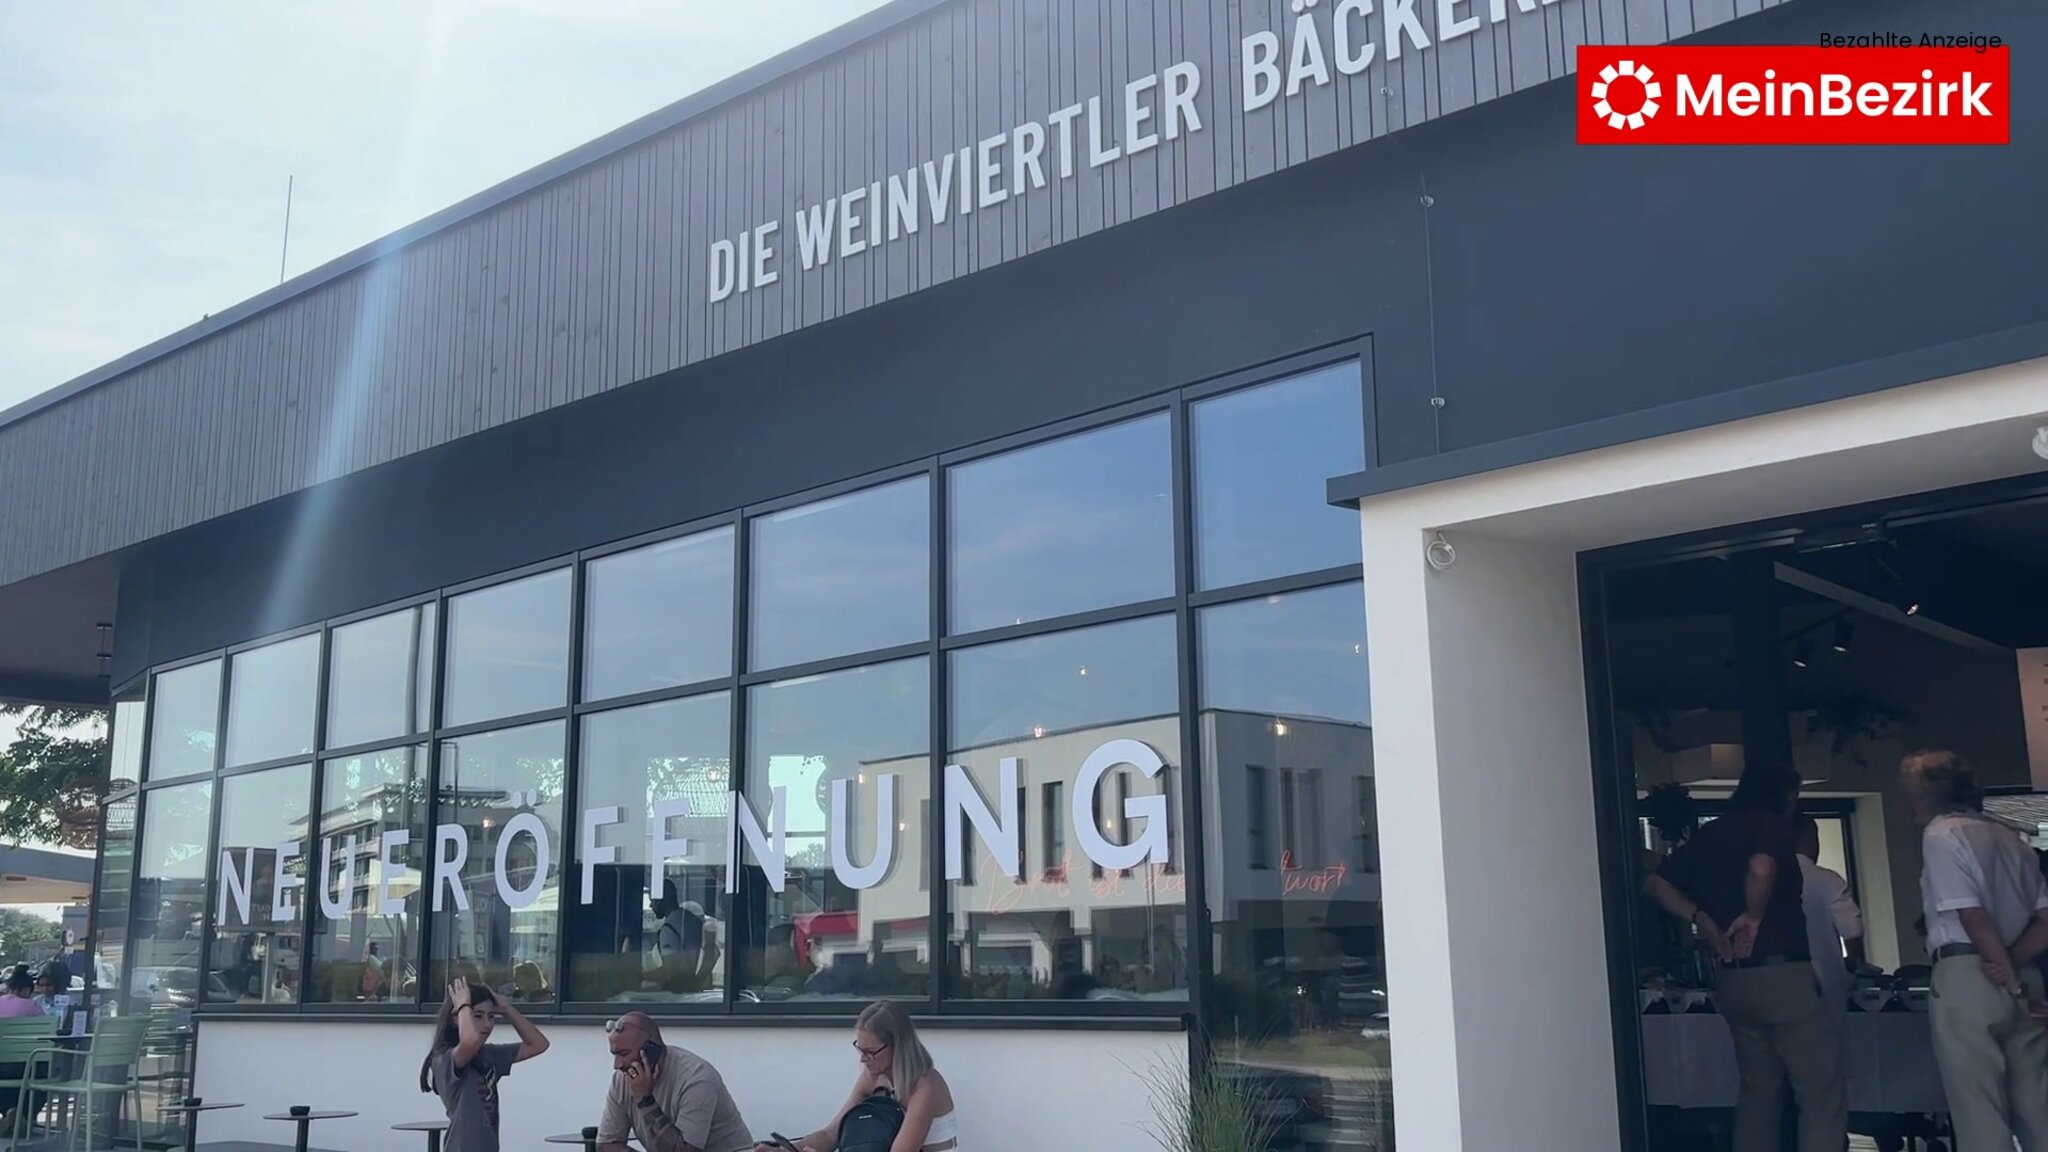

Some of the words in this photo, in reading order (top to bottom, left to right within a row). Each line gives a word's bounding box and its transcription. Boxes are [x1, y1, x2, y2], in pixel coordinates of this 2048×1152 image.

[709, 220, 779, 303] DIE
[796, 60, 1202, 272] WEINVIERTLER
[217, 738, 1168, 926] NEUERÖFFNUNG
